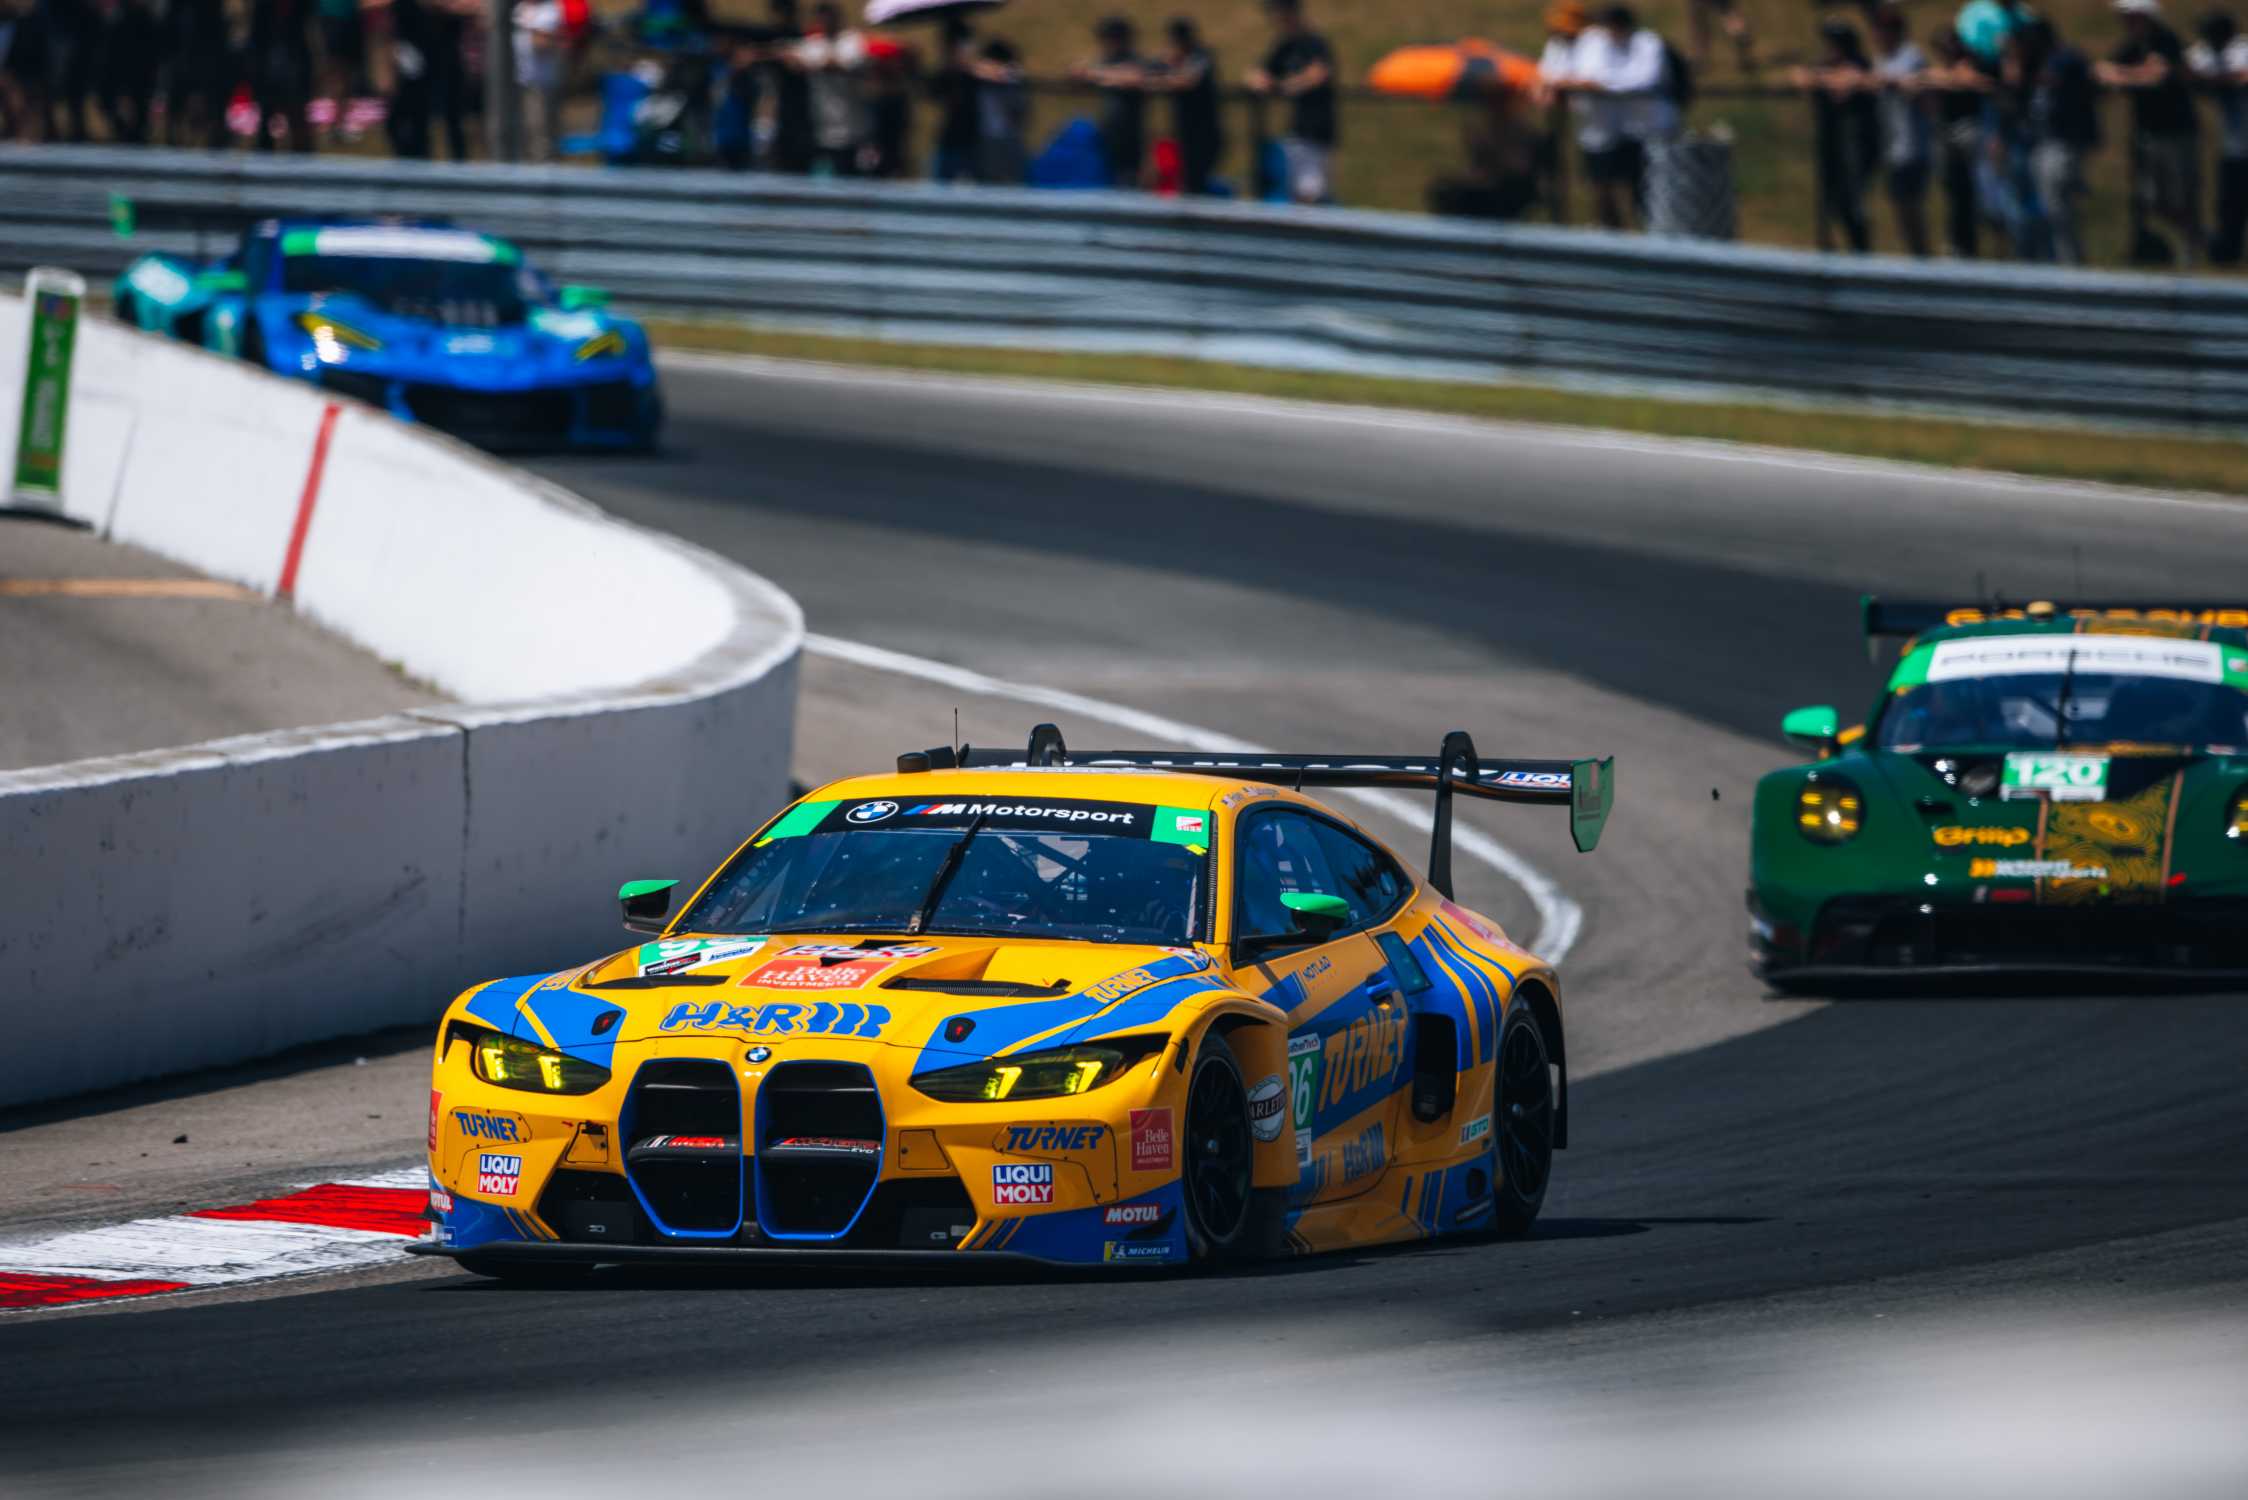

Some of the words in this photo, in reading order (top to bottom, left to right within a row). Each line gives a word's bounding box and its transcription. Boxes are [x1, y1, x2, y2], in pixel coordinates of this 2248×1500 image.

[1506, 773, 1571, 785] LIQ
[2014, 757, 2103, 786] 120
[968, 803, 1135, 825] Motorsport
[1083, 968, 1161, 1003] TURNER
[660, 1001, 807, 1034] H&R
[1318, 990, 1409, 1113] TURNER
[455, 1111, 521, 1143] TURNER
[1145, 1128, 1169, 1144] Belle
[1007, 1126, 1105, 1151] TURNER
[1136, 1141, 1170, 1157] Haven
[480, 1156, 520, 1175] LIQUI
[995, 1166, 1051, 1184] LIQUI
[479, 1175, 518, 1194] MOLY
[994, 1185, 1052, 1203] MOLY
[1105, 1206, 1159, 1222] MOTUL
[1127, 1246, 1170, 1256] MICHELIN
